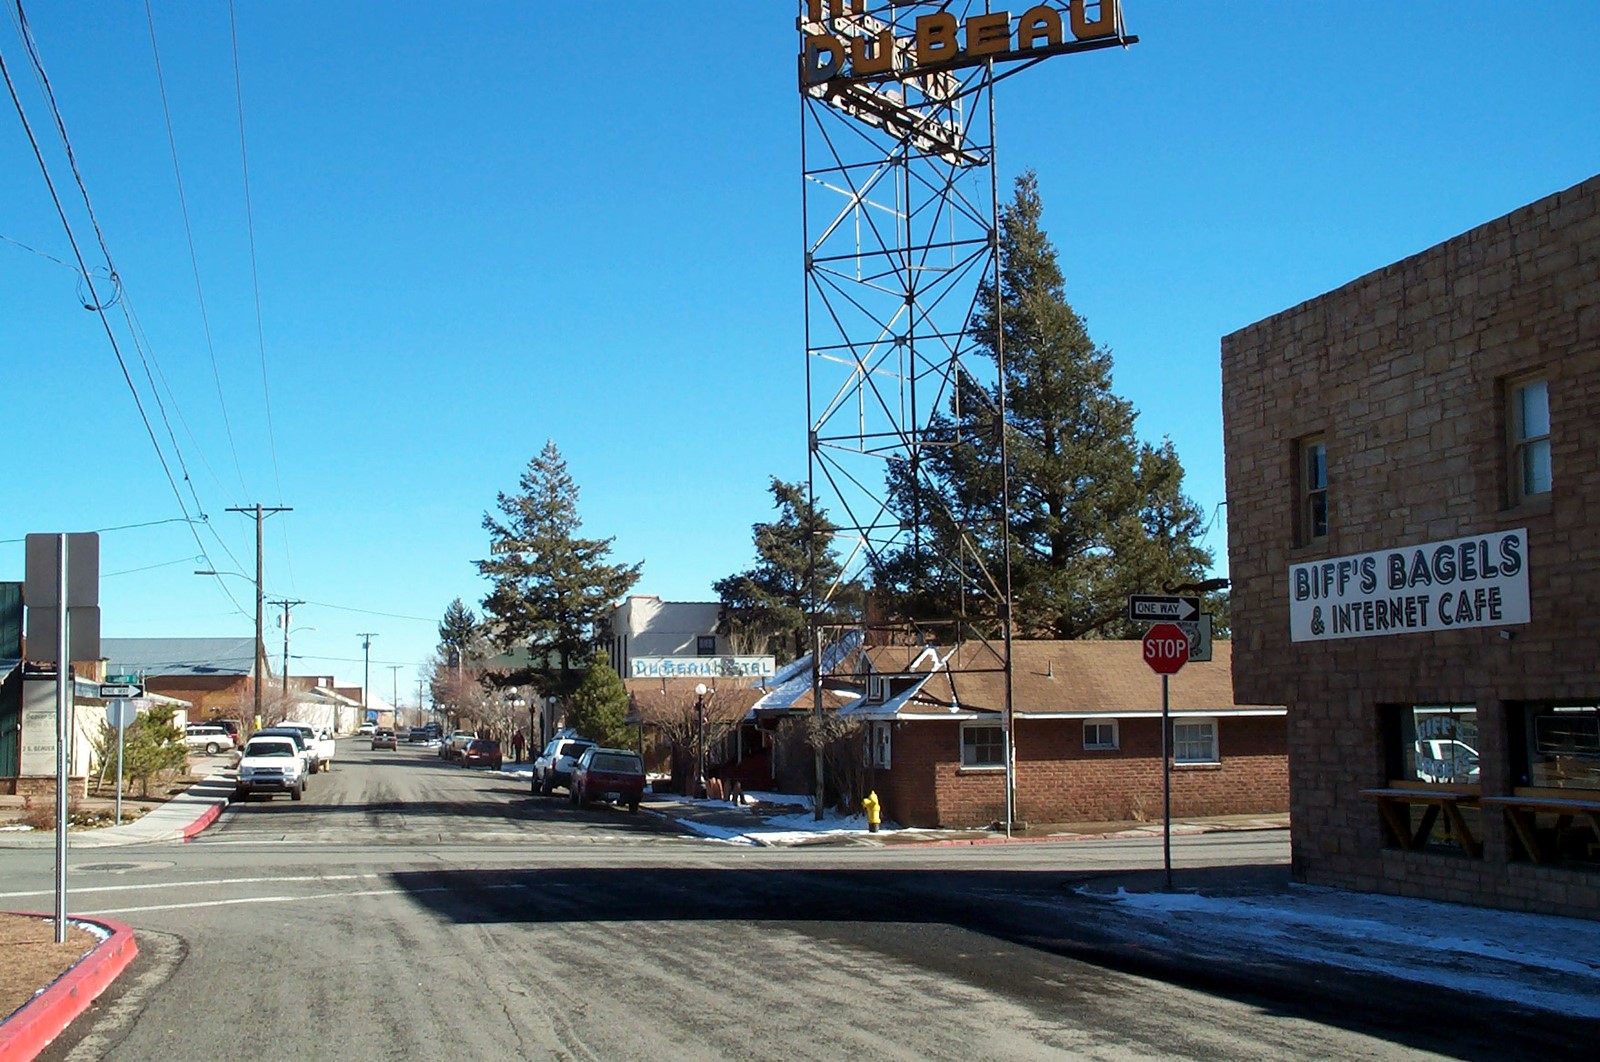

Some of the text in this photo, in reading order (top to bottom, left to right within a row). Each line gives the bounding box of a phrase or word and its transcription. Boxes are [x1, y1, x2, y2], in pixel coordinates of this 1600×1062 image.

[804, 0, 1116, 84] DU BEAU
[1293, 534, 1522, 602] BIFF'S BAGELS
[1137, 603, 1179, 614] ONE WAY
[1311, 587, 1502, 635] & INTERNET CAFE
[1145, 639, 1186, 659] STOP
